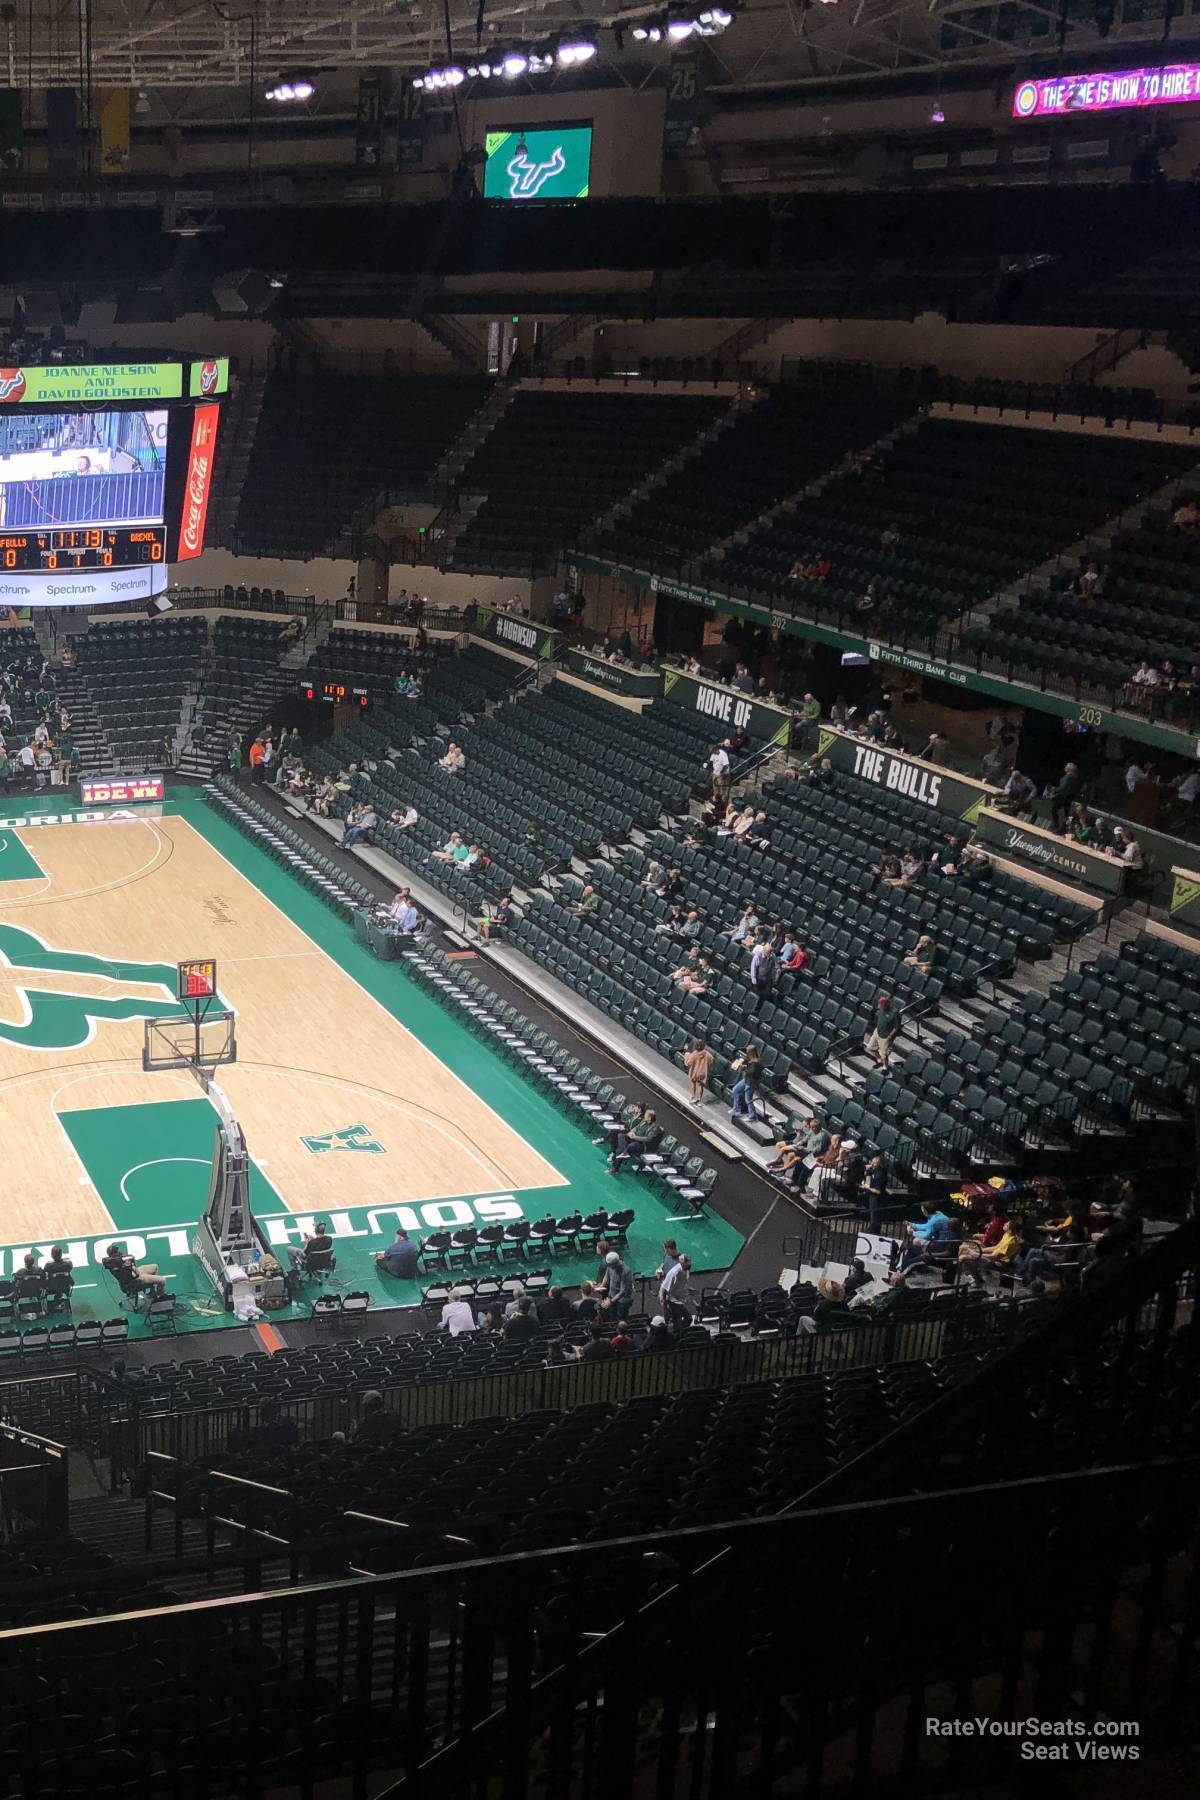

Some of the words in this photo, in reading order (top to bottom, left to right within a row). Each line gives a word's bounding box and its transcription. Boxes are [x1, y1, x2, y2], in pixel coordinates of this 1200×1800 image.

[671, 67, 696, 100] 25
[1043, 86, 1066, 108] THE
[1097, 81, 1110, 103] IS
[1112, 77, 1140, 100] NOW
[1162, 71, 1194, 96] HIRE
[42, 367, 99, 378] JOANNE
[102, 366, 157, 376] NELSON
[84, 378, 115, 387] AND
[38, 389, 81, 399] DAVID
[84, 387, 161, 398] GOLDSTEIN
[38, 539, 45, 548] 4
[57, 529, 101, 549] 11:13
[108, 536, 116, 545] 4
[130, 532, 157, 542] DREXEL
[6, 550, 17, 567] 0
[103, 553, 112, 567] 0
[151, 543, 163, 560] 0
[49, 555, 57, 569] 0
[47, 583, 94, 596] Spectrum
[110, 580, 145, 593] Spectrum
[771, 615, 787, 630] 202
[496, 617, 538, 649] #HORNSUP
[881, 650, 901, 664] FIFTH
[902, 655, 925, 671] THIRD
[925, 661, 946, 677] BANK
[949, 671, 967, 683] CLUB
[696, 685, 733, 722] HOME
[734, 696, 753, 729] OF
[1078, 706, 1102, 727] 203
[853, 745, 885, 783] THE
[886, 759, 943, 807] BULLS
[1005, 828, 1056, 862] Yuengling
[1053, 854, 1087, 874] CENTER
[264, 1194, 524, 1246] SOUTH
